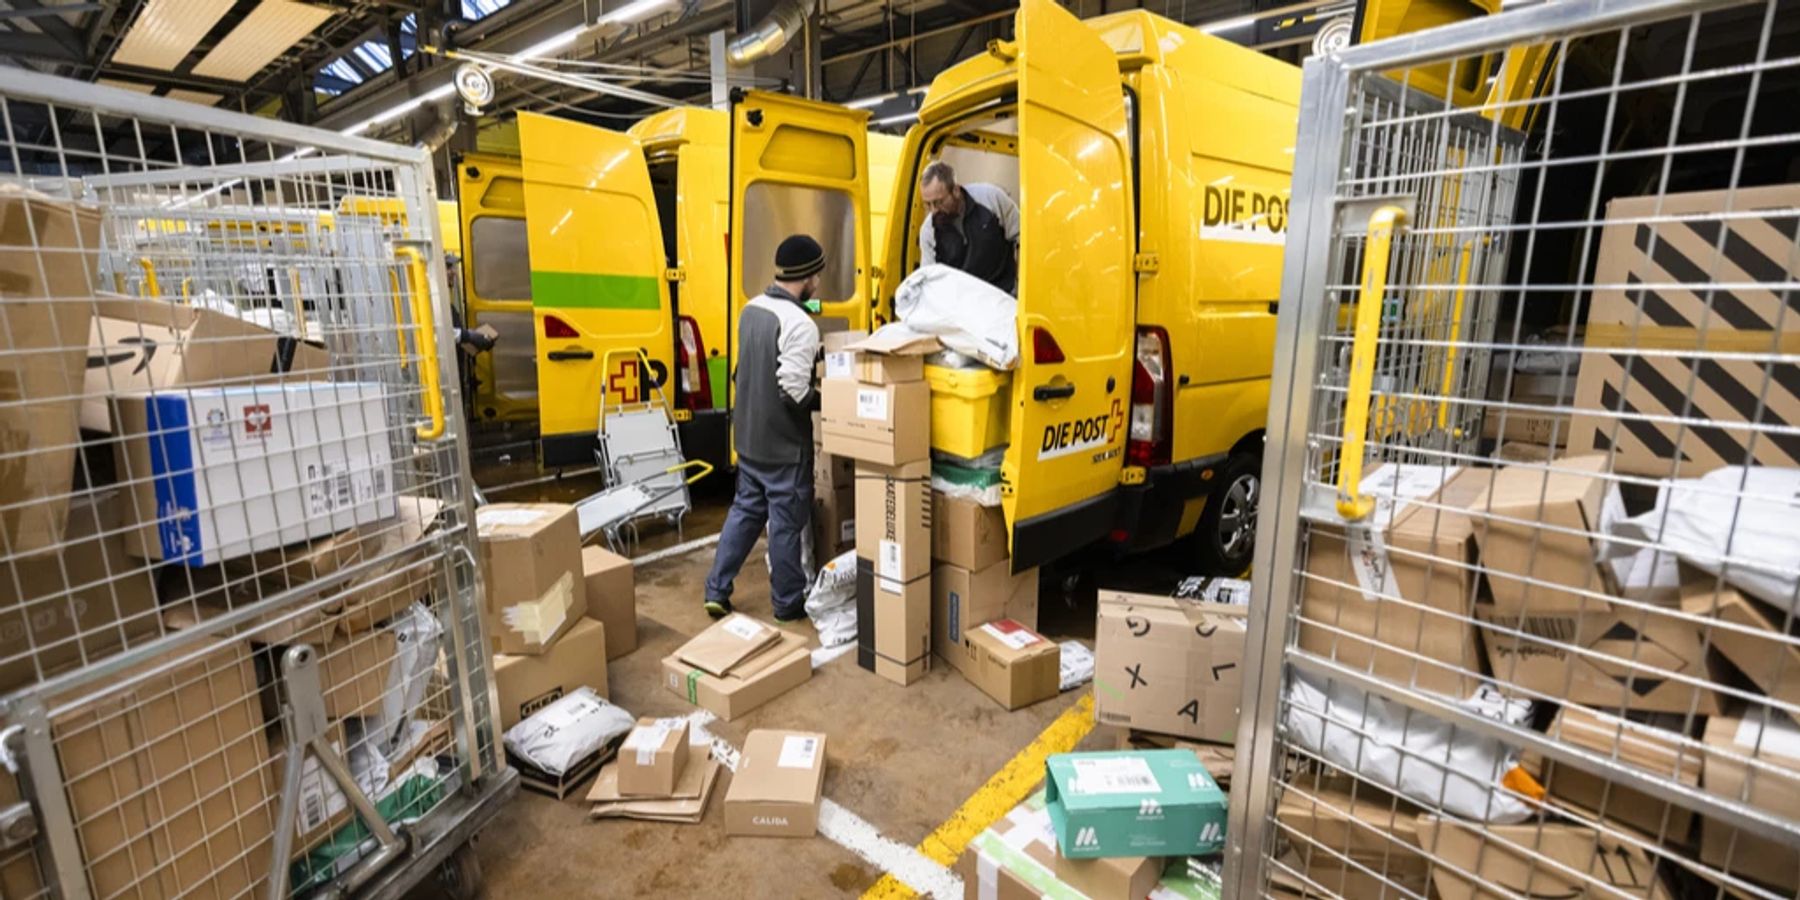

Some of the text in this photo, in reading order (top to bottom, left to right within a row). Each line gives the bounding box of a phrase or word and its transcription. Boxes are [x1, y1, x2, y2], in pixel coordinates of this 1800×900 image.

[1204, 185, 1245, 229] DIE
[1042, 414, 1109, 453] DIE POST
[1177, 699, 1199, 725] A
[752, 816, 789, 826] CALIDA
